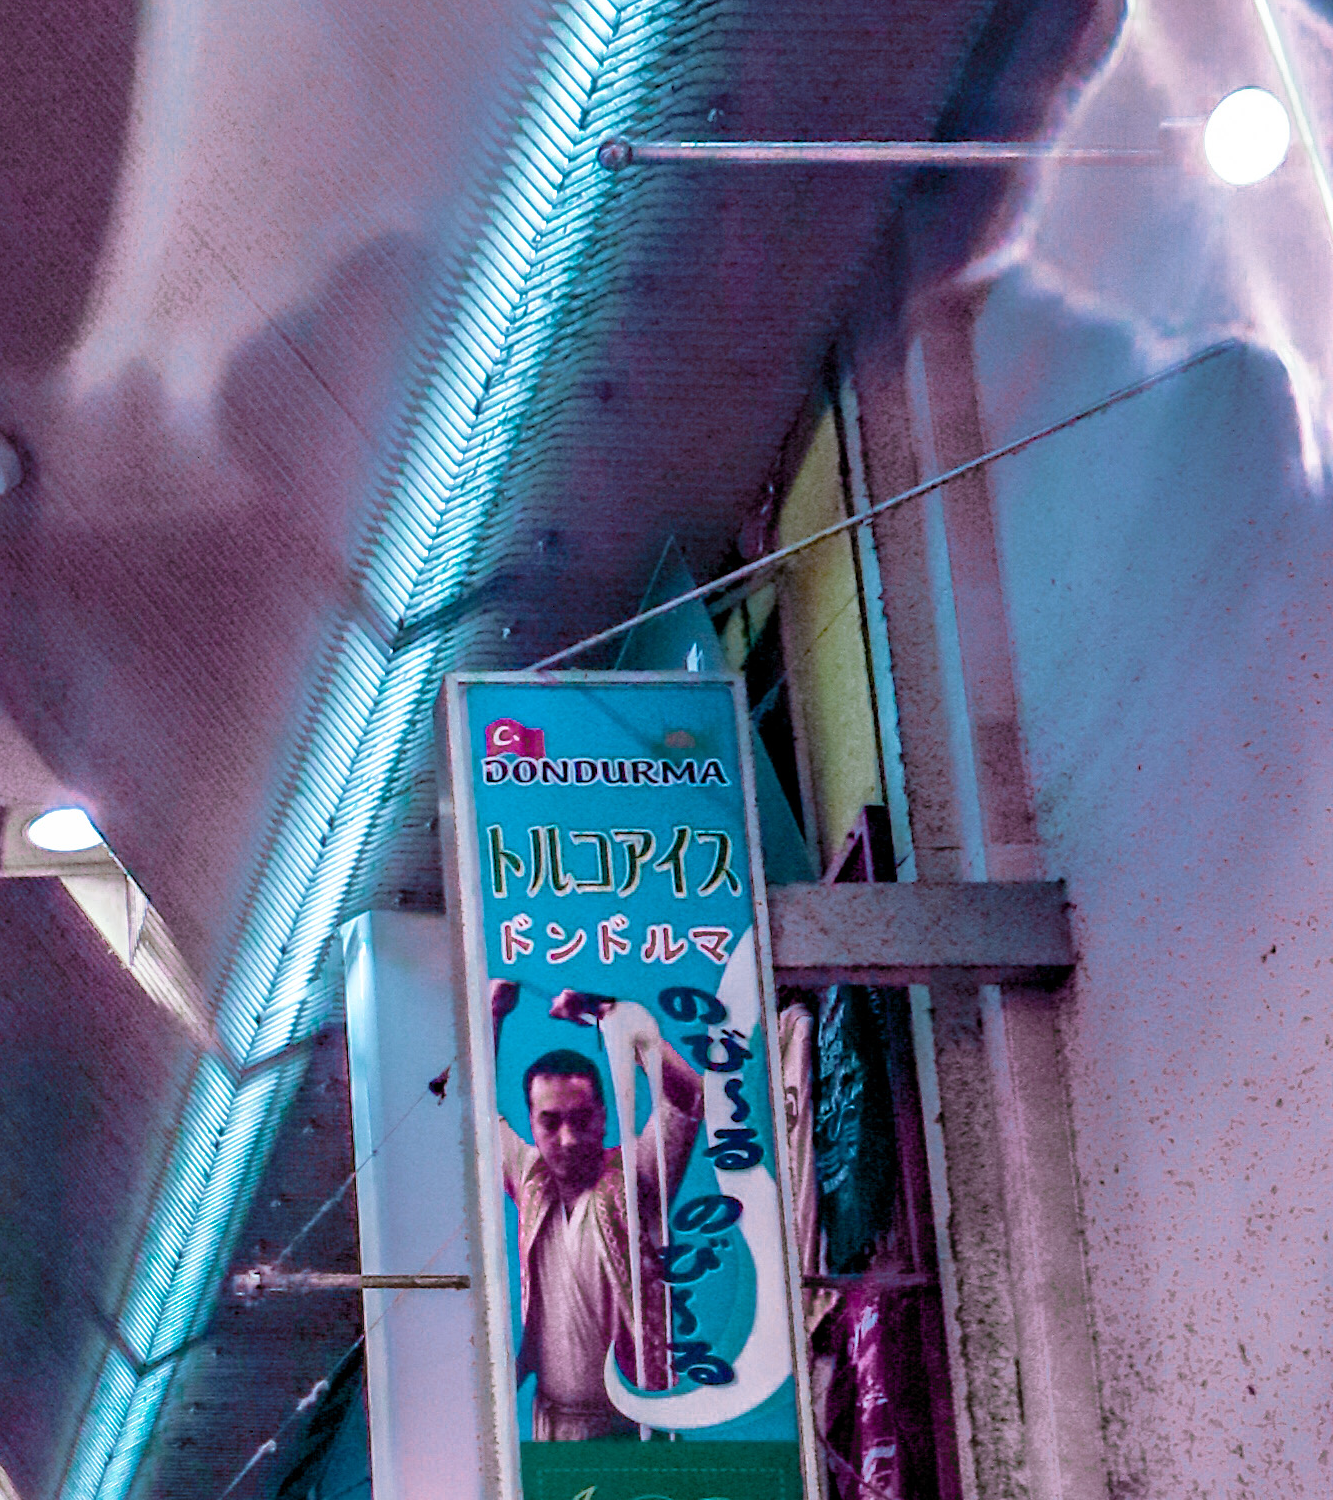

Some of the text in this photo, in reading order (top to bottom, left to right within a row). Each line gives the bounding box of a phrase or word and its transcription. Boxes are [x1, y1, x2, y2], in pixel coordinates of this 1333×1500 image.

[483, 757, 728, 788] DONDURMA
[487, 825, 742, 899] トルコアイス
[502, 917, 733, 965] ドンドルマ
